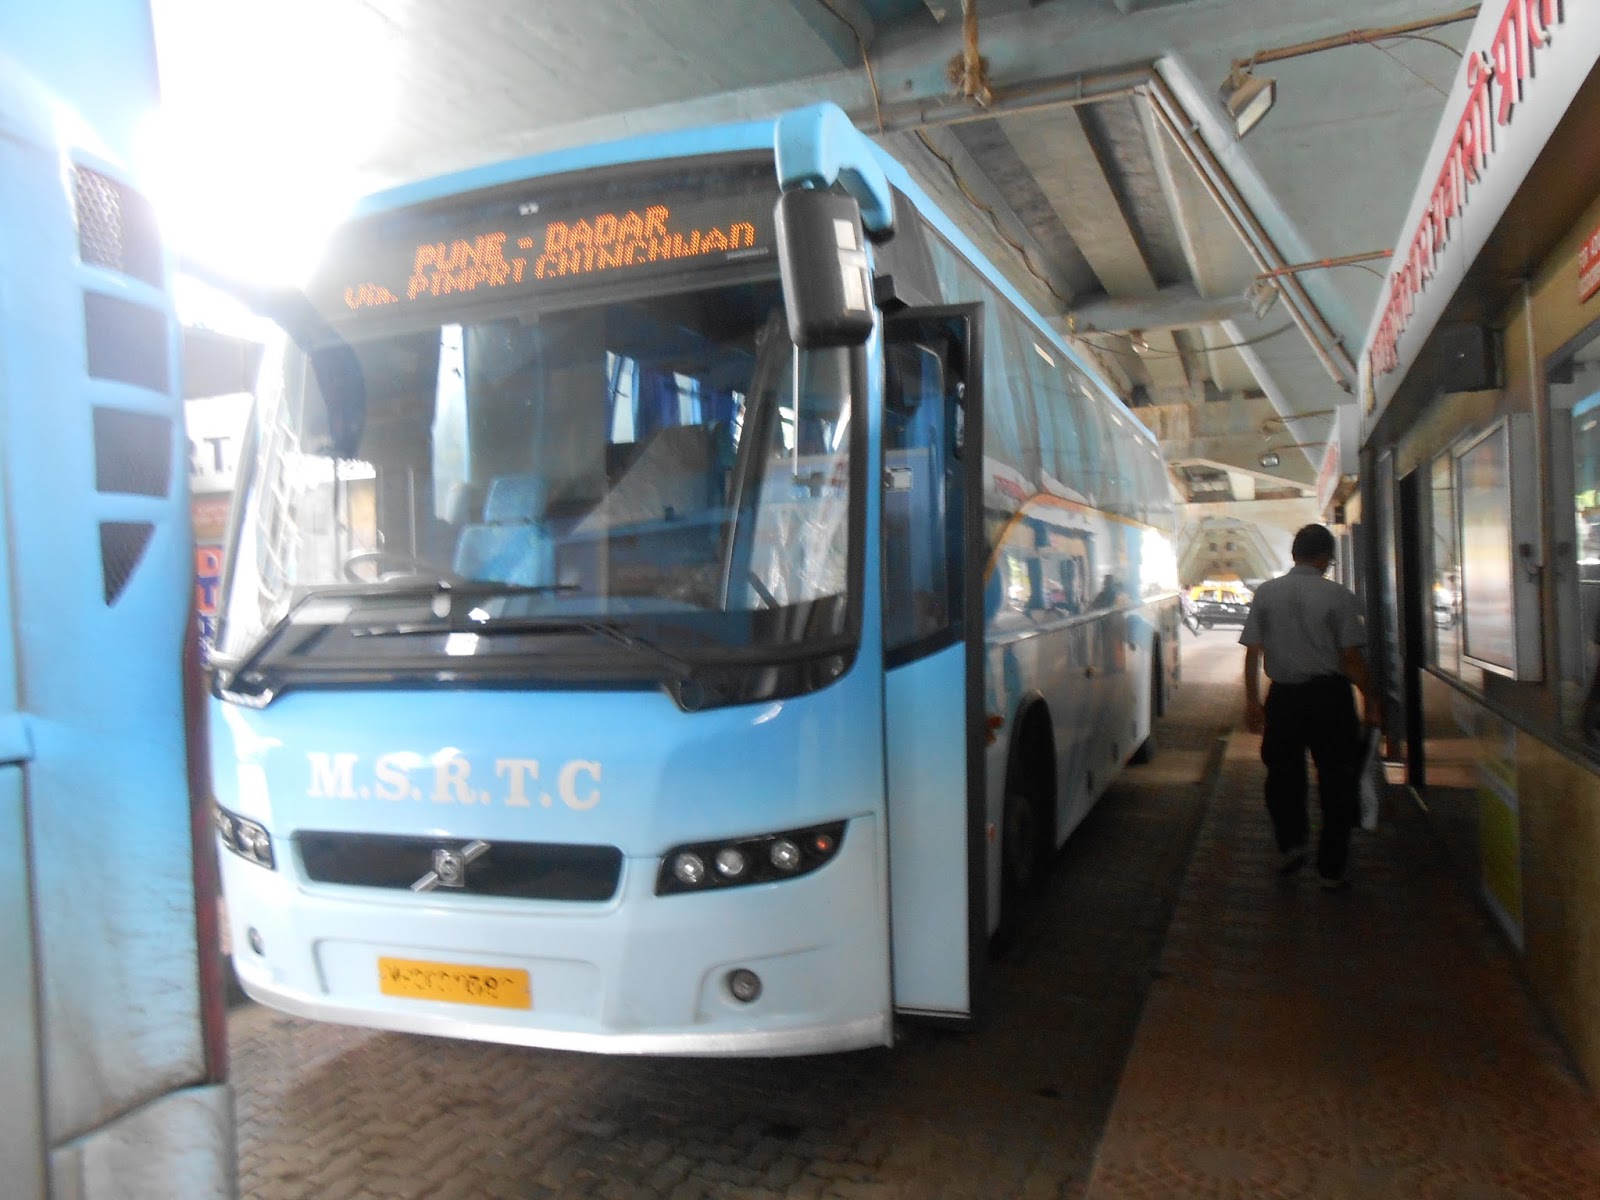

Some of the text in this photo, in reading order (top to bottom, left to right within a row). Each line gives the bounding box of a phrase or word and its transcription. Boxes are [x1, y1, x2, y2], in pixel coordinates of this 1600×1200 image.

[413, 231, 507, 277] PUNE
[545, 205, 669, 254] DADAR
[306, 750, 602, 811] M.S.R.T.C
